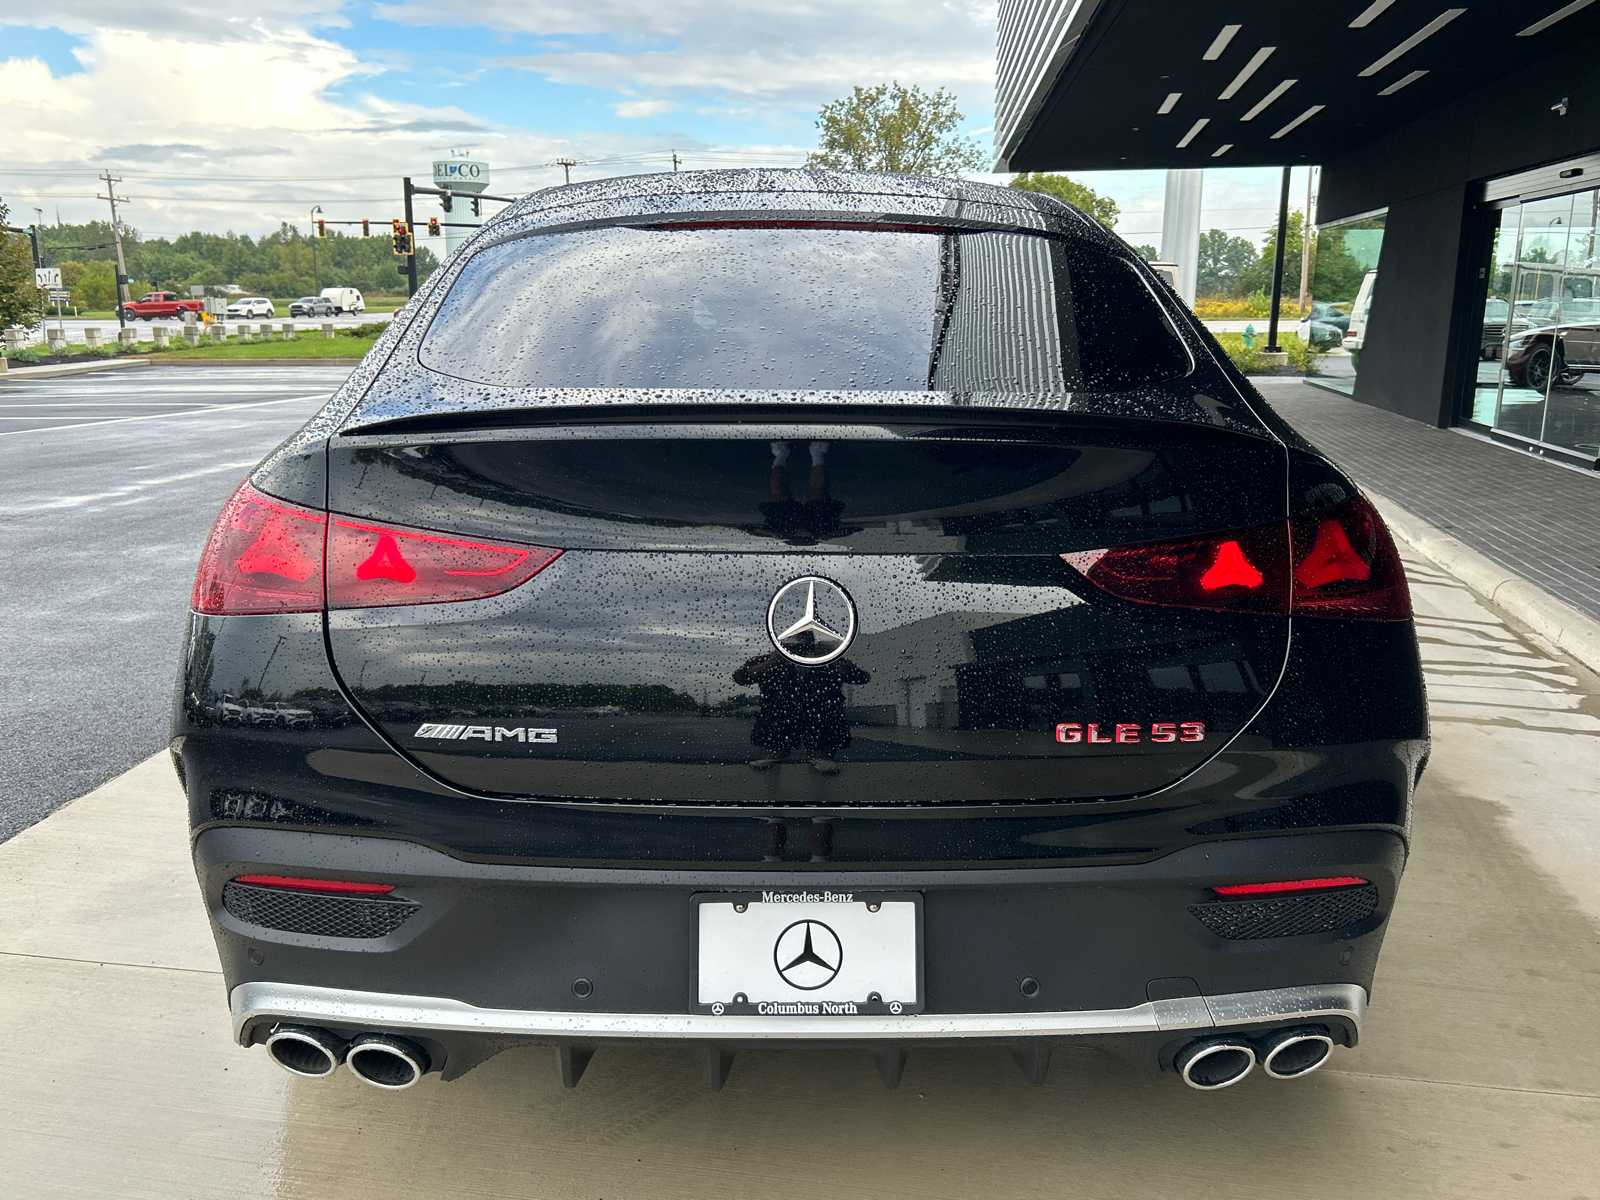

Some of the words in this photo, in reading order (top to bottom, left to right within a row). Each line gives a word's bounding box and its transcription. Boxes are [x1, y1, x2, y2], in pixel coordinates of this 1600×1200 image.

[458, 163, 480, 177] CO
[459, 725, 558, 744] AMG
[1055, 723, 1142, 744] GLE
[1151, 722, 1206, 743] 53
[761, 891, 853, 903] Mercedes-Benz
[758, 1001, 819, 1014] Columbus
[821, 1001, 858, 1014] North
